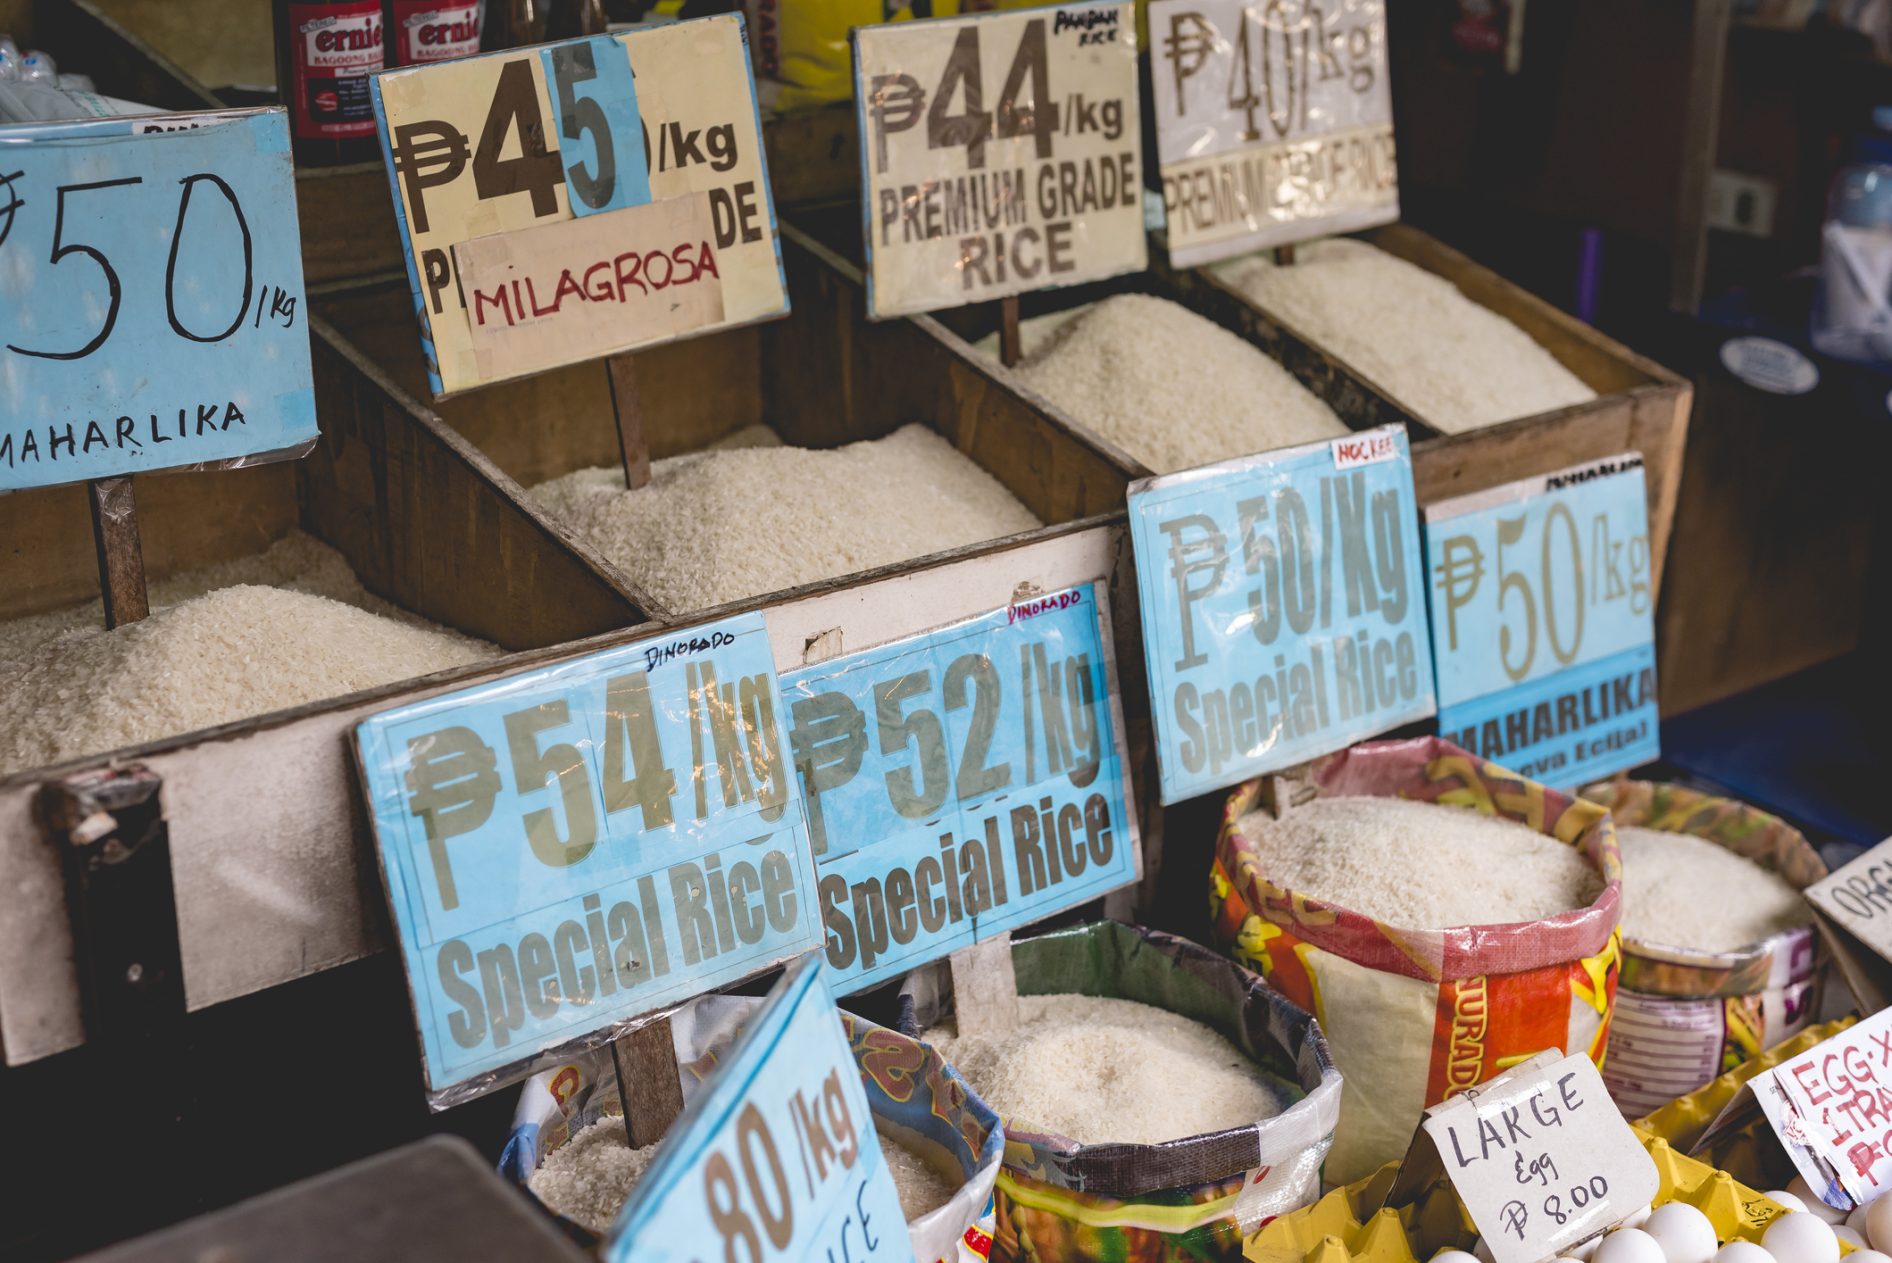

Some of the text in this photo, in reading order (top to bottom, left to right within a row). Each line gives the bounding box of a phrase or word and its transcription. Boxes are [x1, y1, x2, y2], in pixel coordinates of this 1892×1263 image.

[880, 152, 1135, 246] PREMIUM GRADE
[473, 241, 719, 326] MILAGROSA
[959, 222, 1076, 291] RICE
[645, 631, 735, 672] DINORADO
[1007, 589, 1082, 625] DINORADO
[1174, 629, 1418, 776] Special Rice
[818, 792, 1114, 970] Special Rice
[437, 849, 798, 1049] Special Rice
[1447, 1072, 1584, 1169] LARGE
